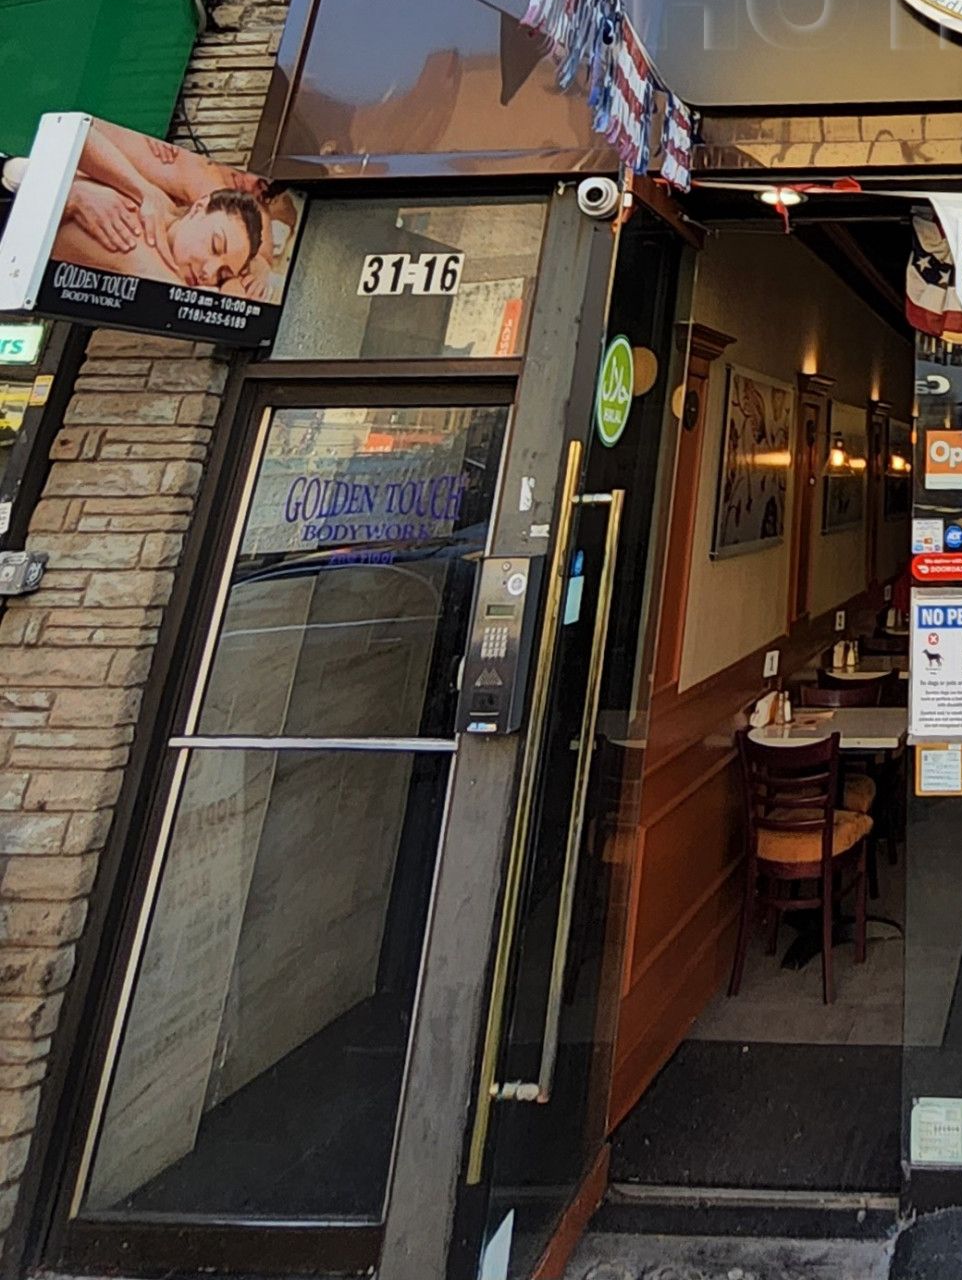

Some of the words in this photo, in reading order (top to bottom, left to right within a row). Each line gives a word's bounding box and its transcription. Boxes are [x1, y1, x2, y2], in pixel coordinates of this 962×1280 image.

[54, 262, 100, 290] GOLDEN
[103, 275, 141, 302] TOUCH
[363, 254, 461, 293] 31-16
[60, 289, 122, 309] BODYWORK
[169, 287, 197, 304] 10:30
[197, 295, 213, 307] am
[220, 297, 245, 313] 10:00
[245, 305, 261, 317] pm
[177, 307, 247, 330] (718)-255-6189
[285, 476, 380, 523] GOLDEN
[386, 474, 468, 522] TOUCH
[302, 523, 432, 541] BODYWORK
[922, 608, 944, 626] NO
